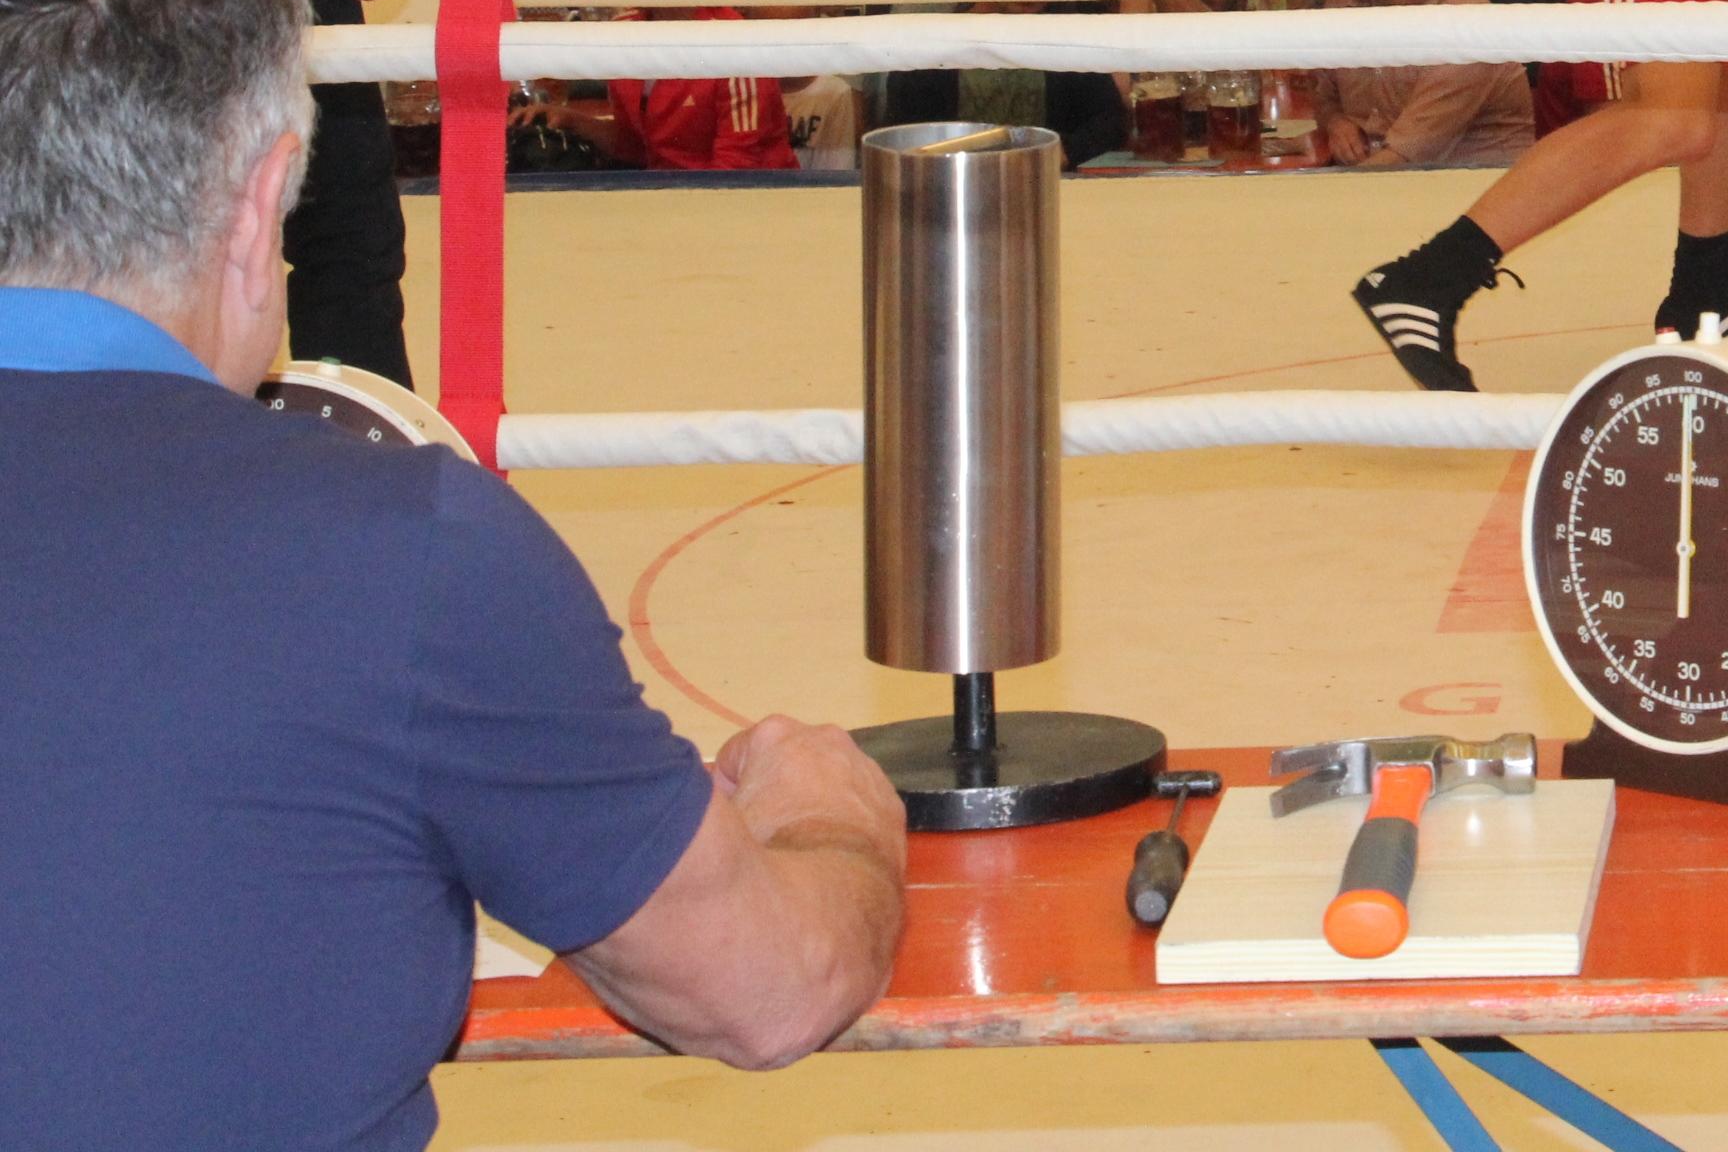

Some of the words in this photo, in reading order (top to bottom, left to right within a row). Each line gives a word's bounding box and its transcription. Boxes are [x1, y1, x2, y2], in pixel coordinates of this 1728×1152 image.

[1645, 374, 1661, 388] 95
[1684, 371, 1703, 384] 100
[1608, 393, 1624, 409] 90
[321, 405, 333, 418] 5
[367, 427, 382, 443] 10
[1580, 425, 1595, 445] 85
[1637, 426, 1659, 445] 55
[1562, 470, 1574, 490] 80
[1603, 468, 1626, 486] 50
[1664, 473, 1719, 488] JUNHANS
[1555, 523, 1566, 540] 75
[1590, 527, 1612, 546] 45
[1560, 575, 1573, 593] 70
[1601, 590, 1625, 609] 40
[1577, 624, 1591, 644] 65
[1633, 639, 1656, 659] 35
[1604, 667, 1619, 684] 60
[1677, 661, 1701, 682] 30
[1639, 696, 1655, 712] 55
[1679, 712, 1696, 726] 50
